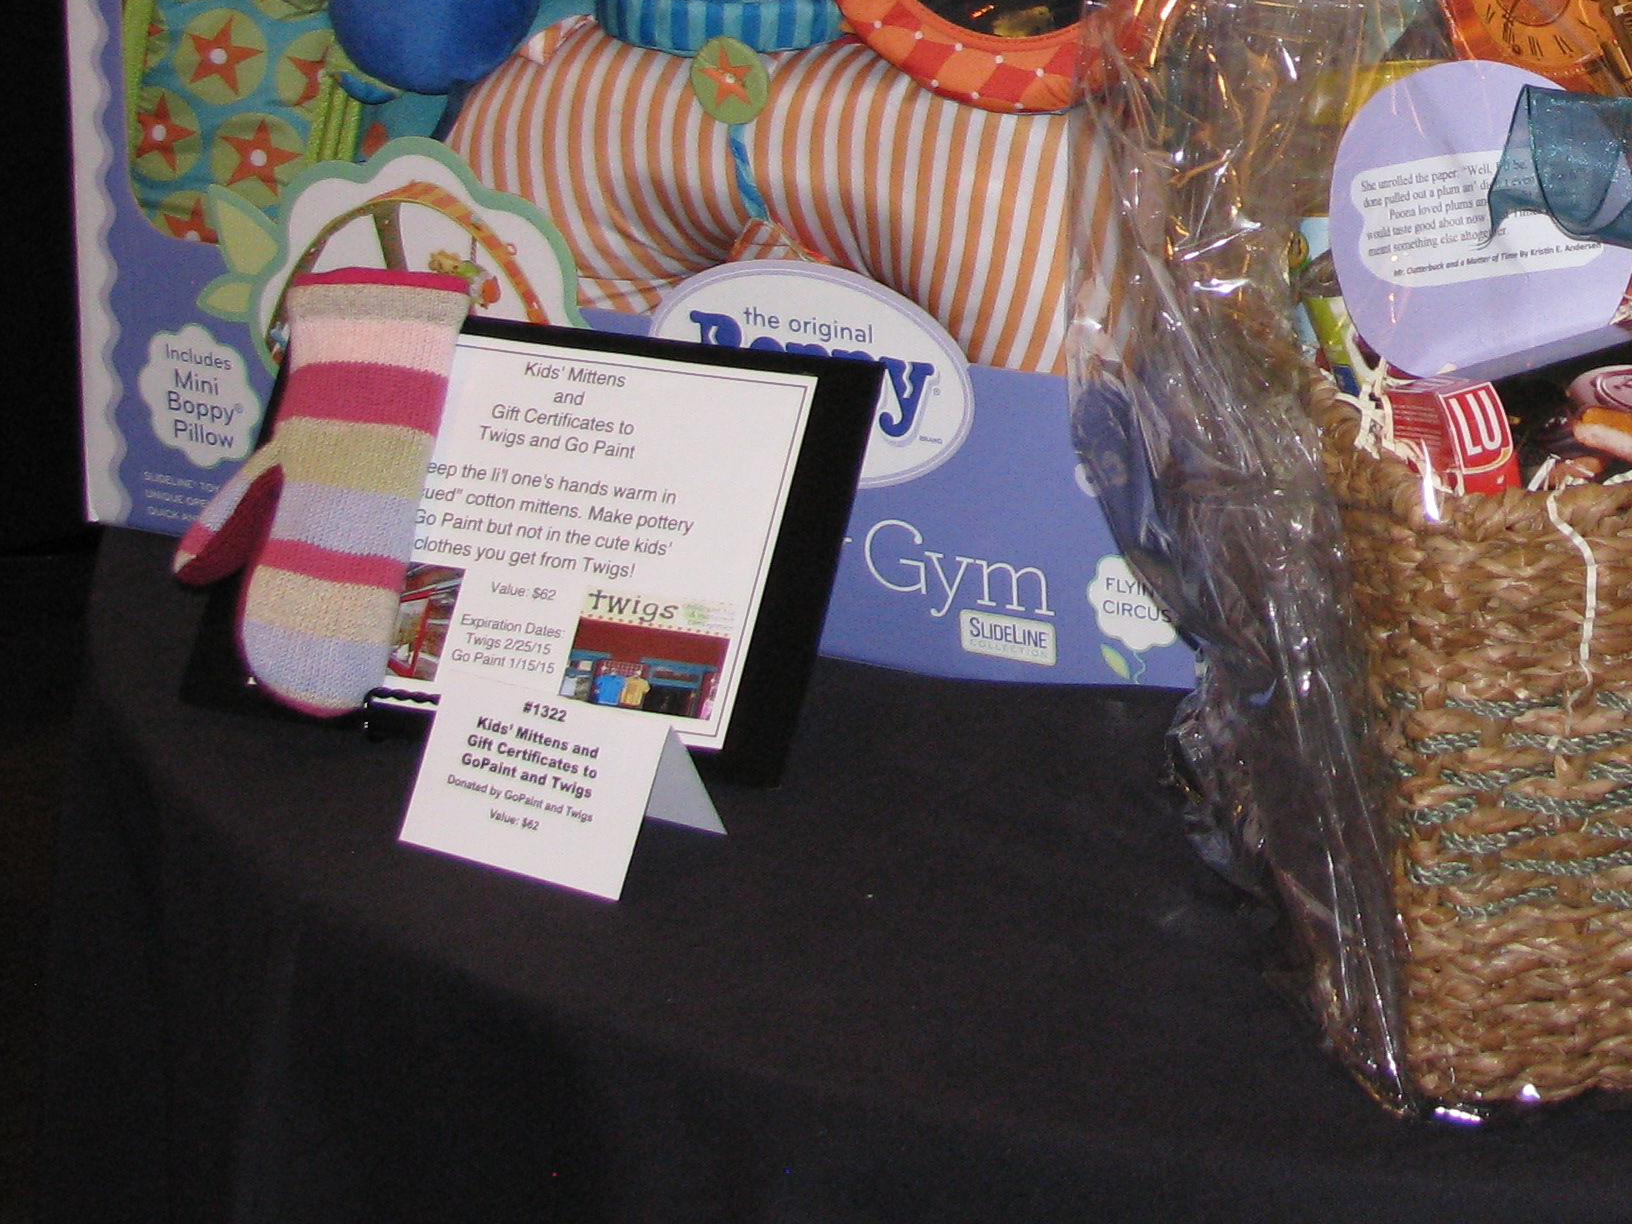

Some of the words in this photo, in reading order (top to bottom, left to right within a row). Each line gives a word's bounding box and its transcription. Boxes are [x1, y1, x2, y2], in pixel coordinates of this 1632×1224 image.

[1415, 172, 1429, 184] the
[744, 307, 780, 329] the
[789, 316, 873, 344] original
[166, 344, 232, 370] Includes
[175, 369, 219, 395] Mini
[524, 361, 566, 380] Kids'
[567, 366, 626, 388] Mittens
[168, 391, 234, 425] Boppy
[554, 390, 585, 406] and
[174, 419, 233, 447] Pillow
[492, 404, 521, 422] Gift
[524, 408, 614, 433] Certificates
[619, 421, 634, 436] to
[1449, 390, 1502, 456] LU
[479, 425, 525, 447] Twigs
[530, 434, 561, 450] and
[565, 437, 589, 454] Go
[594, 440, 635, 460] Paint
[465, 491, 515, 510] cotton
[519, 500, 582, 520] mittens.
[587, 506, 633, 525] Make
[637, 513, 695, 535] pottery
[864, 519, 1055, 617] Gym
[490, 581, 530, 599] Value:
[532, 586, 557, 601] $62
[588, 589, 679, 623] twigs
[1102, 600, 1172, 623] CIRCUS
[460, 614, 523, 634] Expiration
[525, 621, 565, 639] Dates:
[465, 633, 502, 651] Twigs
[504, 636, 552, 656] 2/25/15
[451, 649, 470, 665] Go
[473, 651, 506, 668] Paint
[509, 656, 556, 674] 1/15/15
[523, 701, 567, 722] #1322
[477, 716, 514, 735] Kids'
[515, 727, 568, 751] Mittens
[572, 741, 599, 759] and
[467, 735, 494, 752] Gift
[497, 743, 579, 774] Certificates
[583, 764, 597, 779] to
[462, 753, 517, 778] GoPaint
[520, 770, 547, 786] and
[551, 777, 592, 798] Twigs
[447, 774, 488, 794] Donated
[490, 785, 503, 799] by
[504, 789, 544, 808] GoPaint
[545, 801, 564, 815] and
[566, 806, 593, 823] Twigs
[490, 809, 520, 826] Value:
